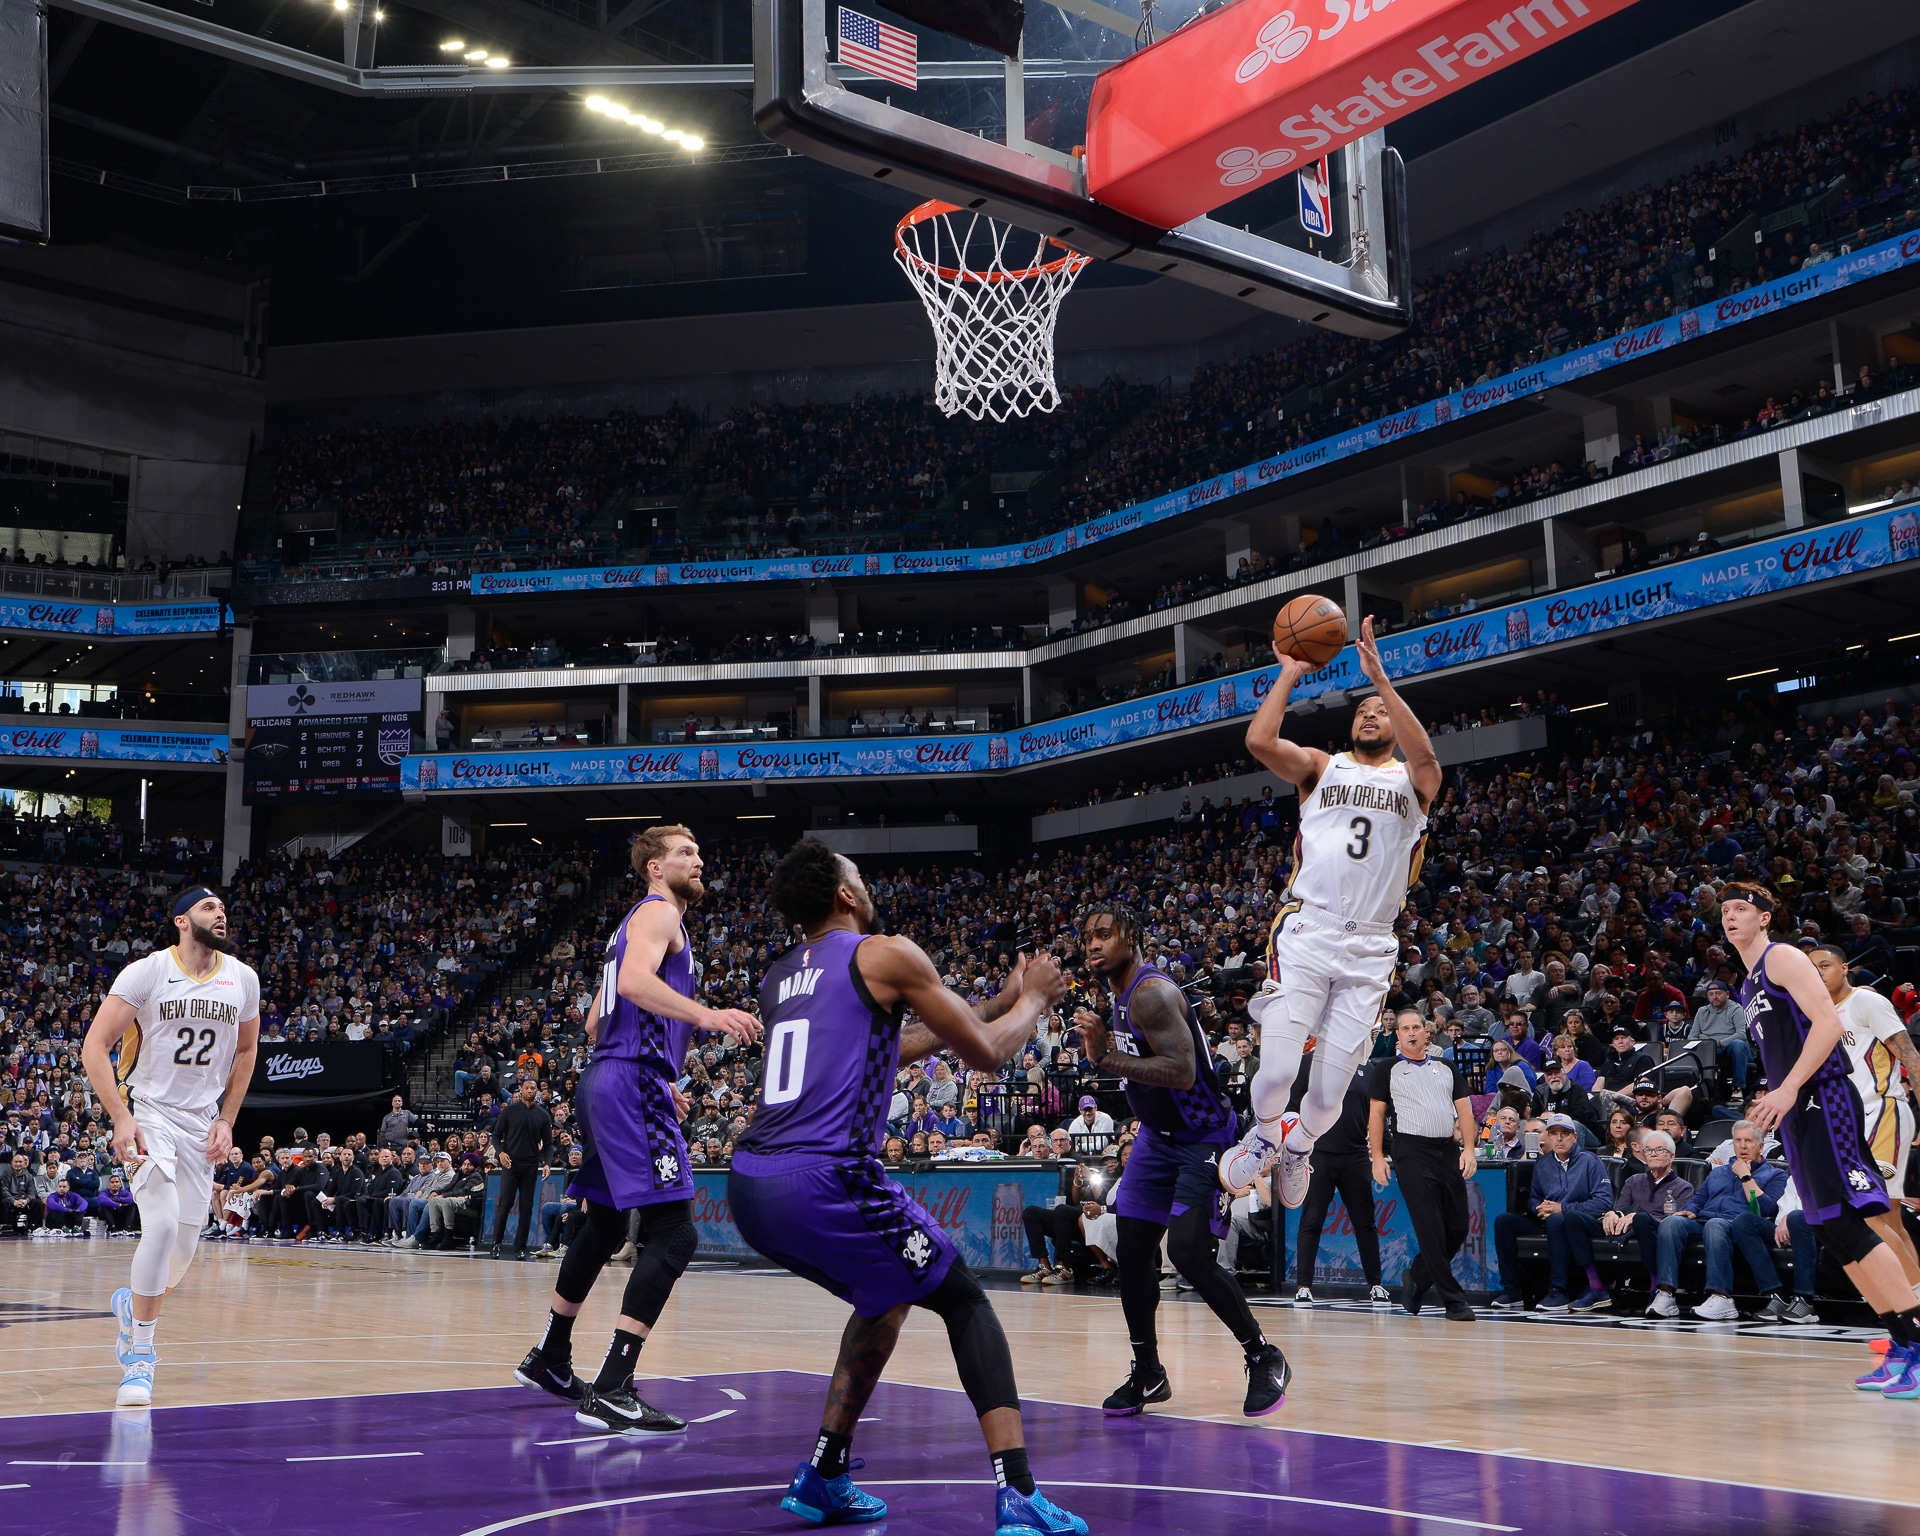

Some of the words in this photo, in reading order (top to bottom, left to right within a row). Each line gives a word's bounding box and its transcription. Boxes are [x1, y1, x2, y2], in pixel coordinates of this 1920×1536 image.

[1304, 208, 1321, 228] NBA
[1837, 254, 1876, 277] MADE
[1880, 247, 1898, 261] TO
[1716, 292, 1772, 321] Coors
[1563, 354, 1594, 372] MADE
[1598, 348, 1612, 359] TO
[1613, 324, 1665, 358] Chill
[1461, 384, 1506, 409] Coors
[1337, 436, 1363, 450] MADE
[1365, 429, 1377, 440] TO
[1378, 409, 1421, 439] Chill
[1258, 457, 1295, 480] Coors
[1154, 500, 1176, 513] MADE
[1177, 495, 1188, 505] TO
[1188, 479, 1224, 504] Chill
[1084, 520, 1116, 539] Coors
[981, 552, 1008, 563] MADE
[1010, 550, 1022, 558] TO
[1023, 537, 1056, 560] Chill
[1701, 563, 1750, 586] MADE
[1755, 557, 1778, 573] TO
[1780, 527, 1863, 573] Chill
[680, 564, 719, 579] Coors
[769, 563, 795, 573] MADE
[797, 563, 810, 571] TO
[811, 557, 854, 573] Chill
[893, 554, 934, 569] Coors
[432, 581, 453, 591] 3:31
[456, 580, 471, 590] PM
[480, 575, 518, 589] Coors
[562, 574, 588, 583] MADE
[590, 573, 602, 582] TO
[604, 568, 645, 584] Chill
[11, 606, 26, 616] TO
[28, 604, 82, 625] Chill
[135, 608, 171, 618] CELEBRATE
[1546, 595, 1612, 628] Coors
[1404, 643, 1421, 657] TO
[1423, 620, 1485, 658] Chill
[330, 691, 376, 699] REDHAWK
[382, 714, 408, 722] KINGS
[1110, 713, 1139, 728] MADE
[1141, 709, 1156, 720] TO
[1157, 690, 1205, 722] Chill
[251, 718, 291, 727] PELICANS
[297, 717, 342, 726] ADVANCED
[343, 716, 368, 724] STATS
[13, 730, 67, 748] Chill
[120, 734, 160, 743] CELEBRATE
[301, 732, 307, 741] 2
[314, 732, 351, 740] TURNOVERS
[357, 731, 363, 739] 2
[1019, 731, 1059, 754] Coors
[301, 747, 307, 755] 2
[317, 746, 332, 754] BCH
[357, 745, 363, 753] 7
[380, 743, 409, 752] KINGS
[856, 749, 893, 760] MADE
[896, 749, 913, 760] TO
[915, 741, 975, 763] Chill
[299, 761, 307, 769] 11
[322, 760, 341, 768] DREB
[356, 759, 363, 767] 3
[571, 760, 605, 770] MADE
[609, 759, 625, 769] TO
[627, 752, 684, 773] Chill
[737, 748, 791, 768] Coors
[793, 752, 840, 766] LIGHT
[452, 759, 504, 778] Coors
[1319, 785, 1351, 809] NEW
[1353, 784, 1409, 819] ORLEANS
[448, 826, 465, 844] 103
[1347, 816, 1372, 860] 3
[214, 978, 234, 986] ibotta
[778, 967, 825, 1004] MONK
[159, 999, 187, 1022] NEW
[190, 999, 238, 1025] ORLEANS
[173, 1026, 216, 1066] 22
[266, 1053, 324, 1081] Kings
[764, 1018, 810, 1105] 0
